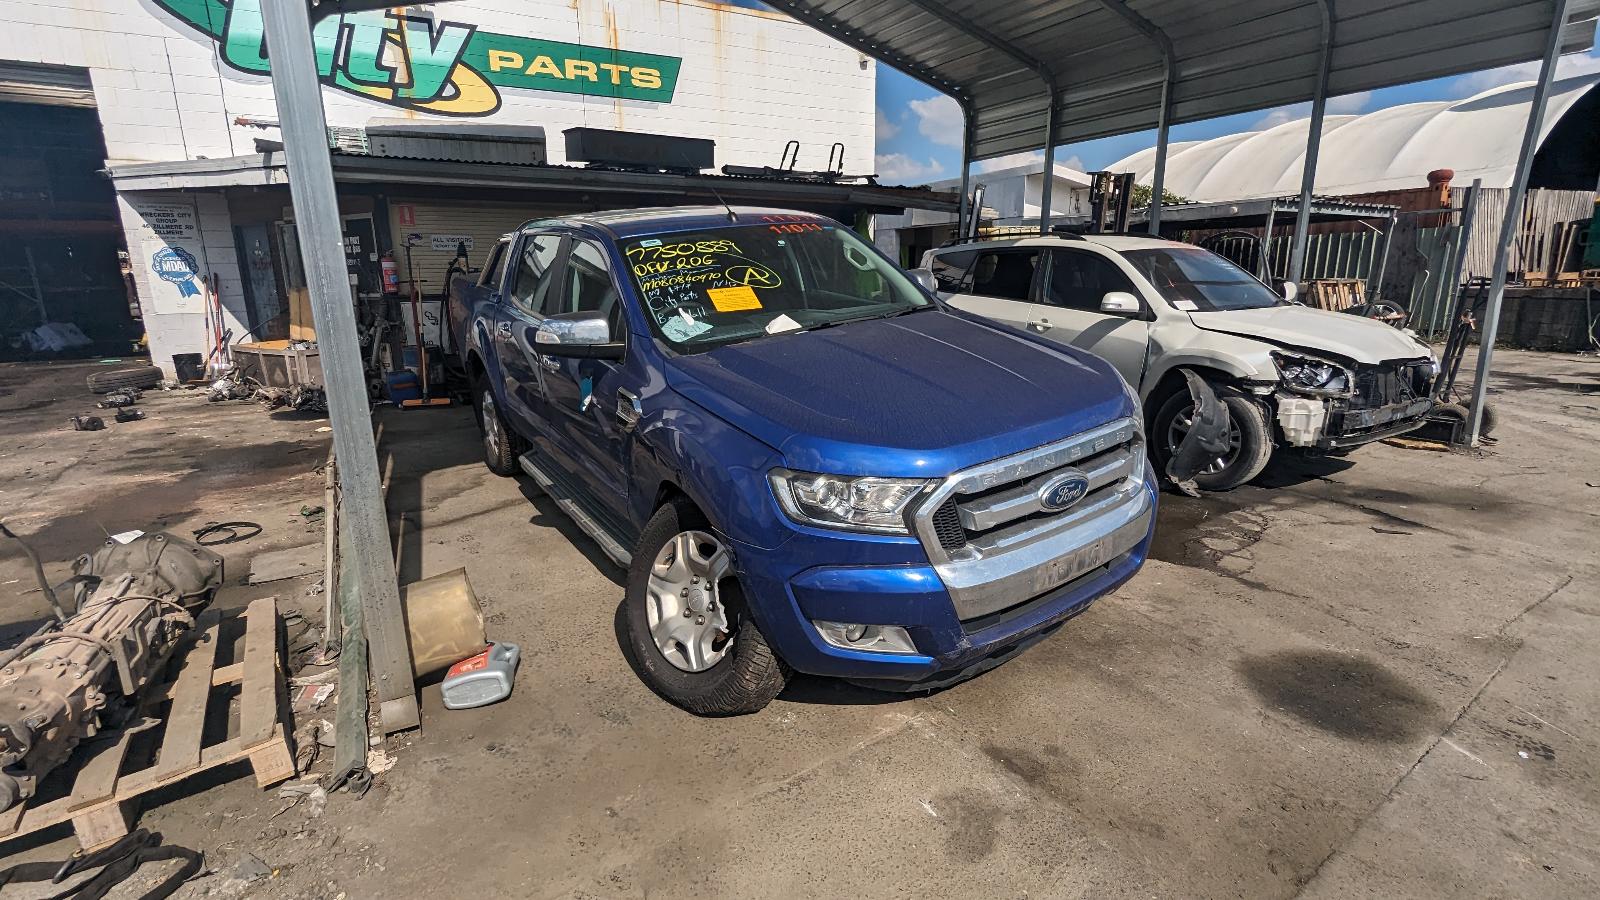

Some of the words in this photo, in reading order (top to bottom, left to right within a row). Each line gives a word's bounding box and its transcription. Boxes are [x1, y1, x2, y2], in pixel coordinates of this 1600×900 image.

[488, 49, 662, 90] PARTS
[744, 267, 770, 285] A
[1056, 483, 1082, 504] Ford
